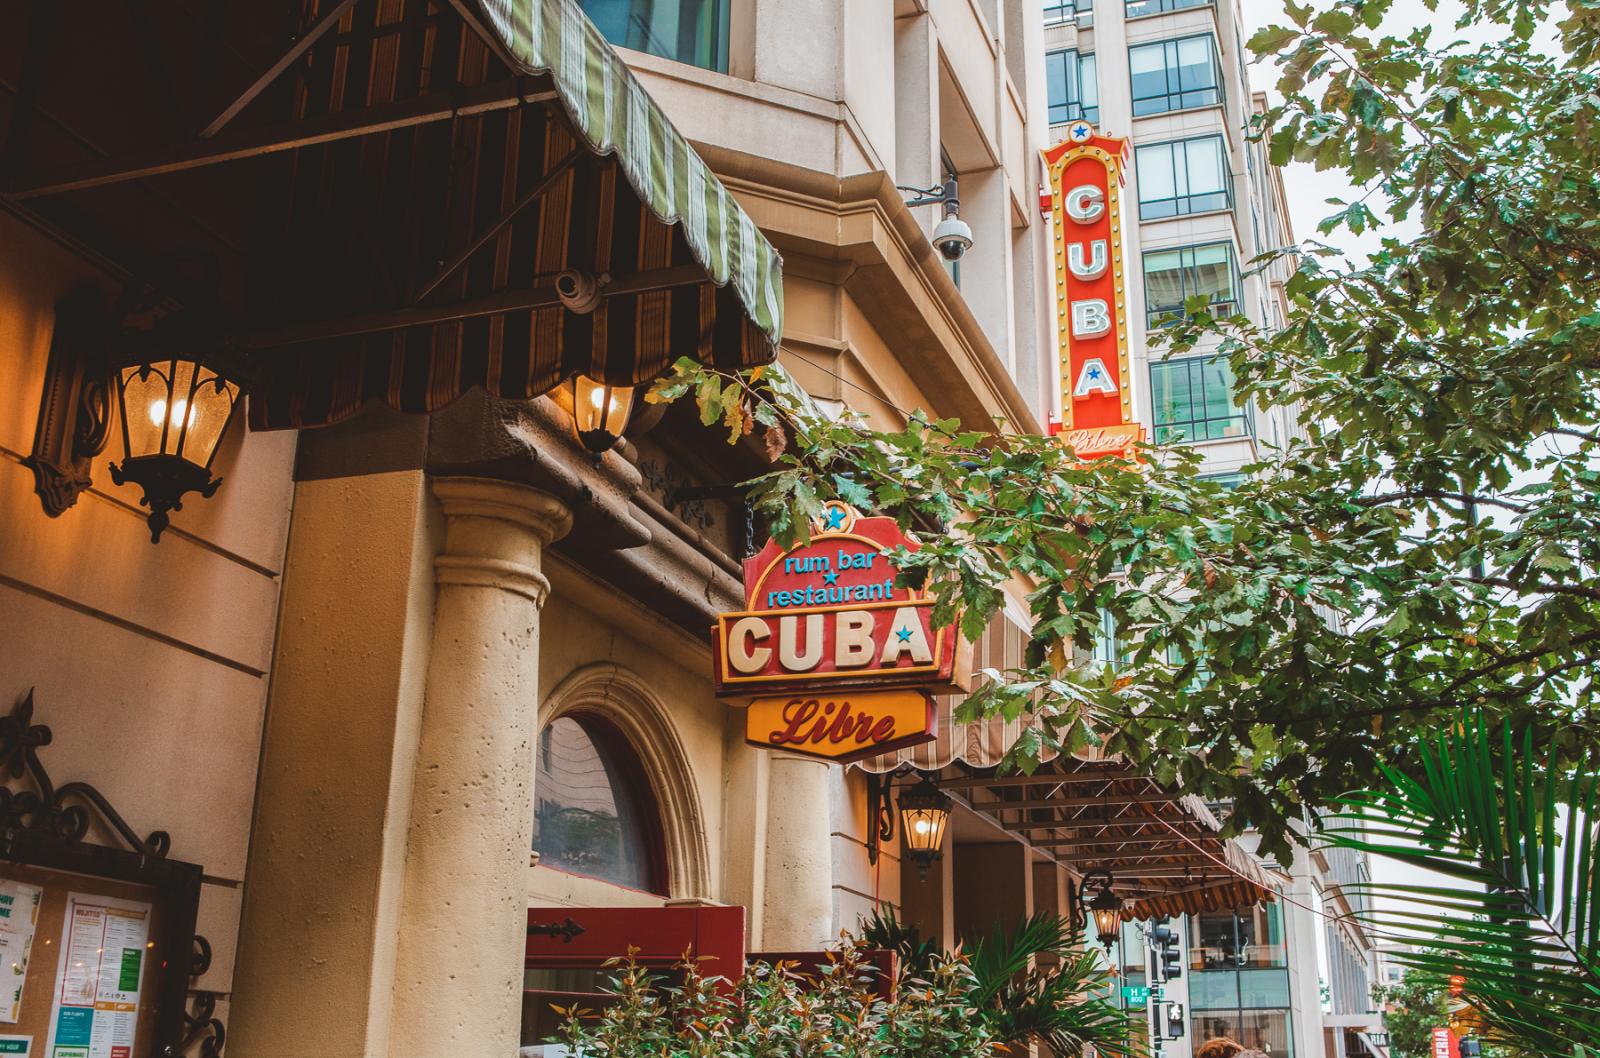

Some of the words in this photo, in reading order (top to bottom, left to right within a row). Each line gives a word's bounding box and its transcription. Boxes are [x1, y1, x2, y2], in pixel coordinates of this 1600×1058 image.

[1065, 184, 1119, 400] CUBA
[1068, 429, 1133, 451] Libre
[785, 555, 830, 575] rum
[838, 550, 877, 572] bar
[768, 578, 893, 608] restaurant
[728, 606, 934, 674] CUBA
[769, 699, 896, 745] Libre
[1131, 988, 1138, 996] H
